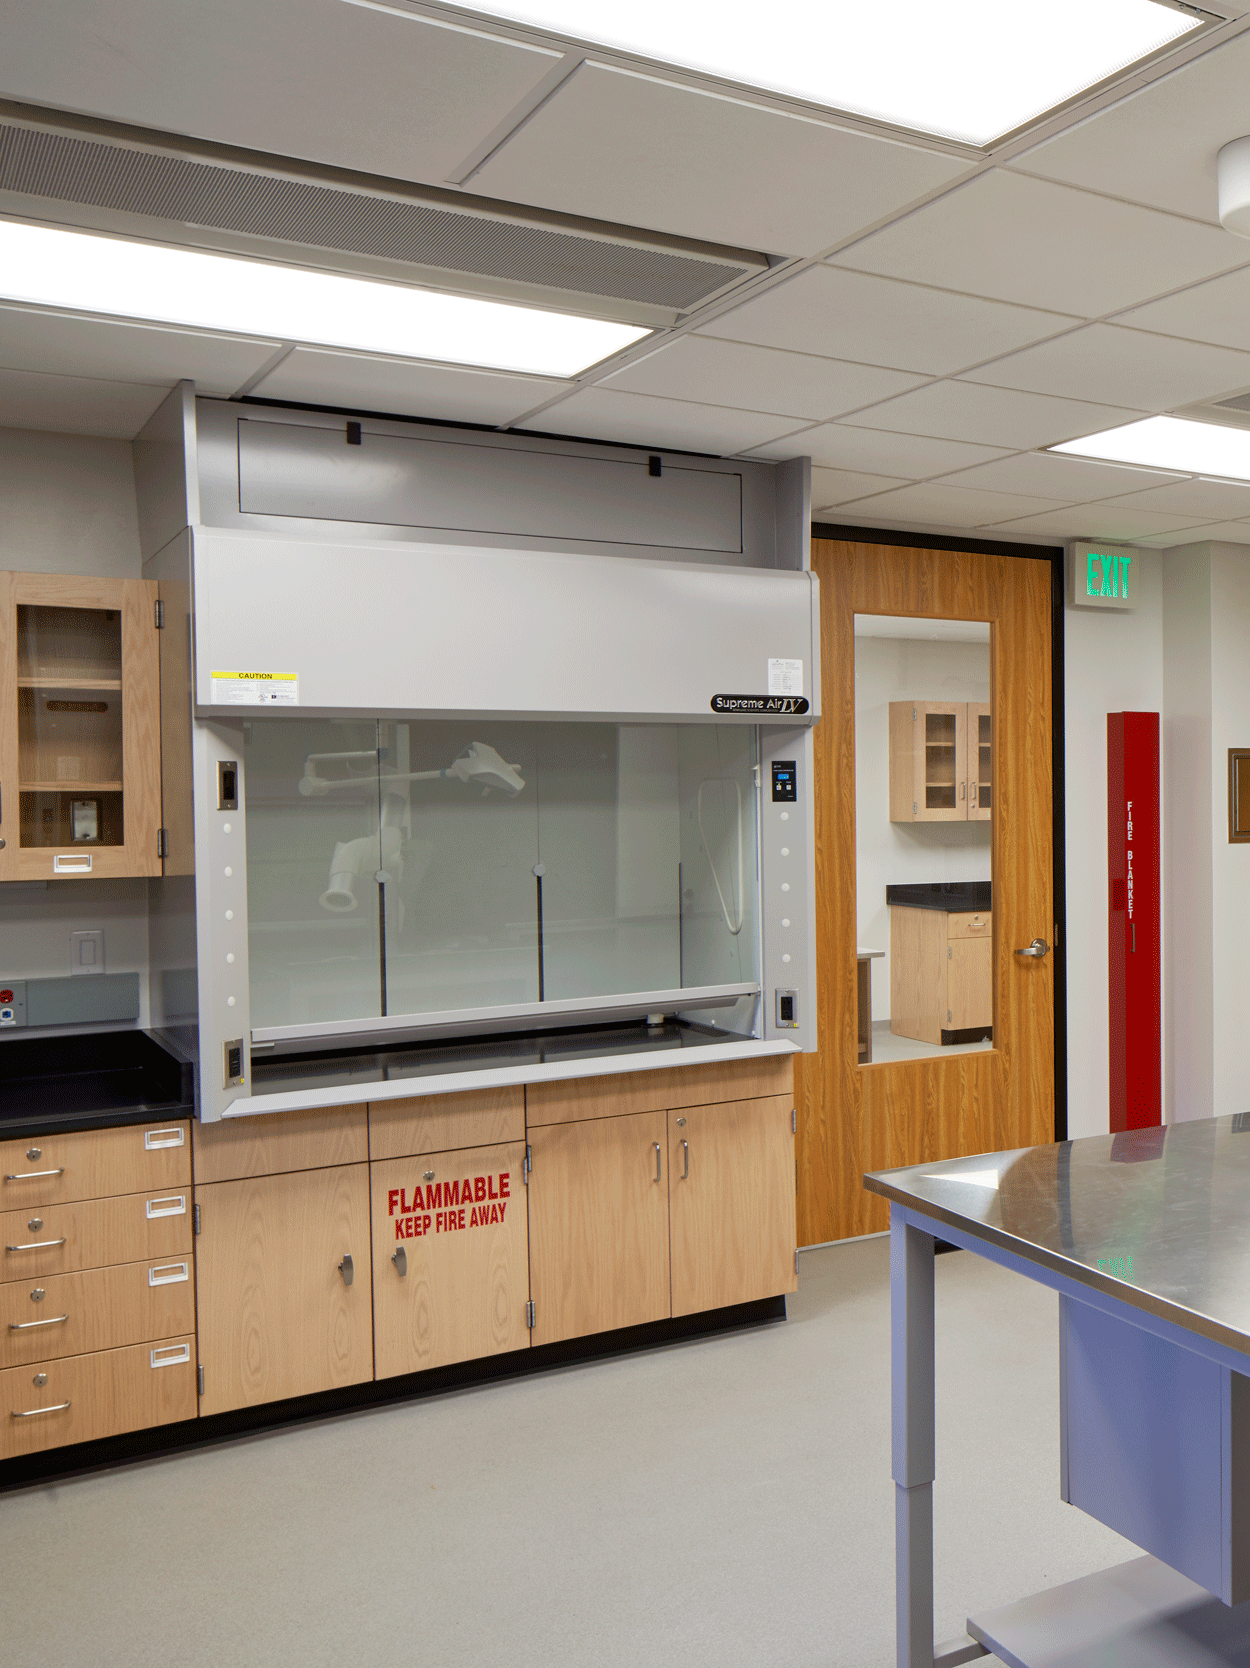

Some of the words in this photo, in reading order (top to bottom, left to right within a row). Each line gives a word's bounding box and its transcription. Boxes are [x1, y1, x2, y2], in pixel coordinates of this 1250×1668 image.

[1086, 553, 1132, 598] EXIT
[716, 697, 764, 710] Supreme
[766, 698, 781, 709] Air
[388, 1172, 510, 1216] FLAMMABLE
[395, 1214, 432, 1240] KEEP
[436, 1208, 466, 1234] FIRE
[469, 1202, 507, 1228] AWAY
